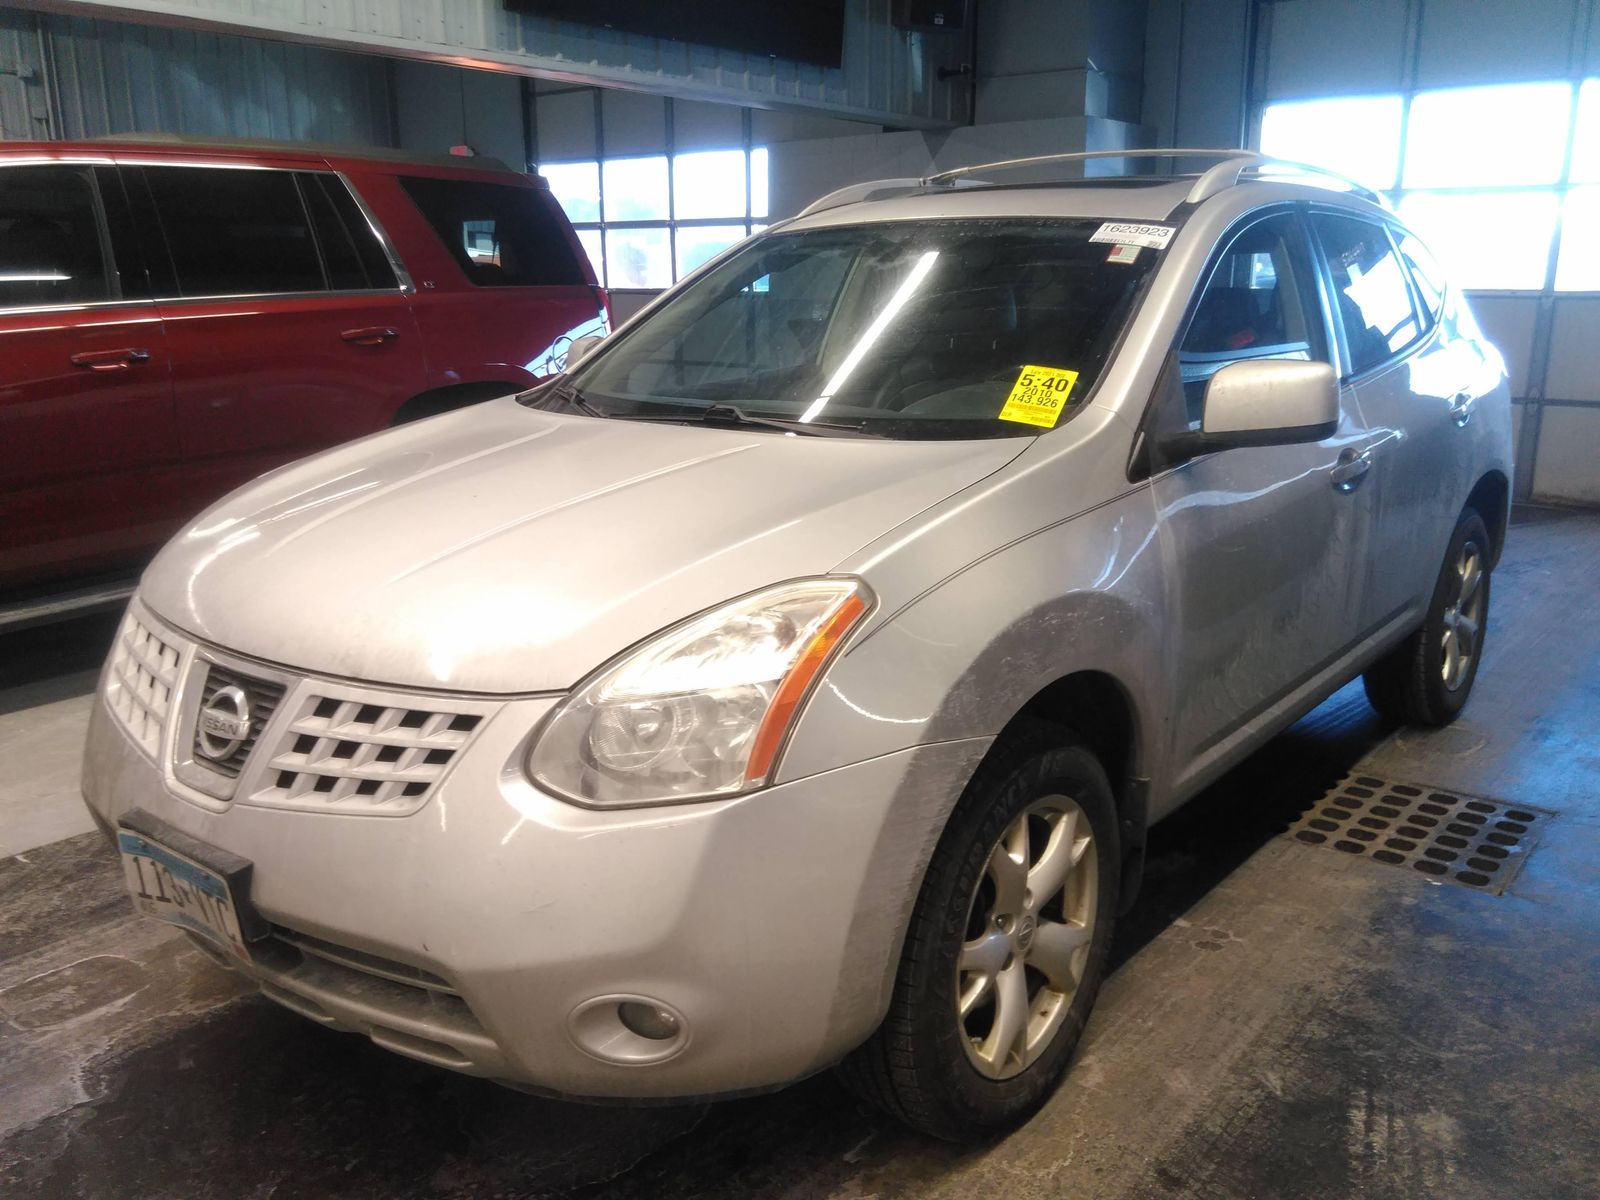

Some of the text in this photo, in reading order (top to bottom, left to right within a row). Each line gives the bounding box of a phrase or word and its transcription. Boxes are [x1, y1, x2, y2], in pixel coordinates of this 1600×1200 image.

[1103, 224, 1169, 237] 1623923
[1020, 374, 1069, 392] 5:40
[1023, 387, 1053, 398] 2010
